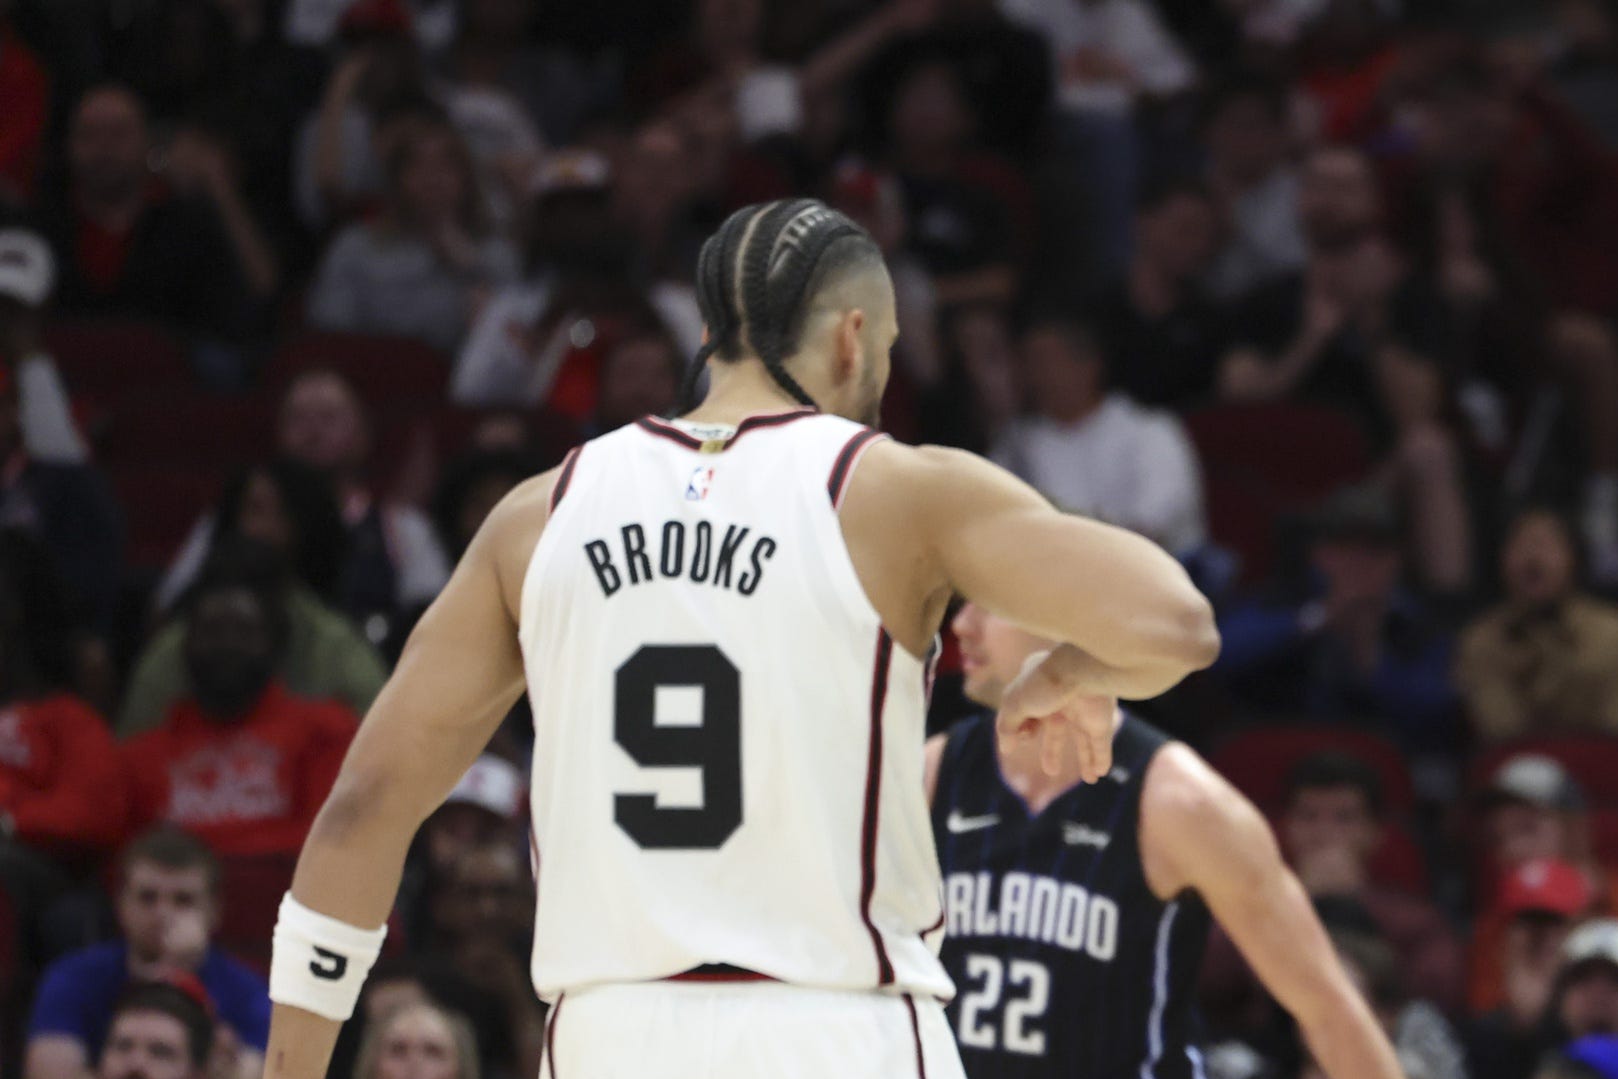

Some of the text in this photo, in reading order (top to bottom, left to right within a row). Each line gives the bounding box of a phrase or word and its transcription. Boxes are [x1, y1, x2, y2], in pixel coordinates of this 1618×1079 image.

[584, 520, 777, 598] BROOKS
[612, 643, 745, 851] 9
[942, 871, 1119, 962] RLANDO
[958, 953, 1050, 1057] 22
